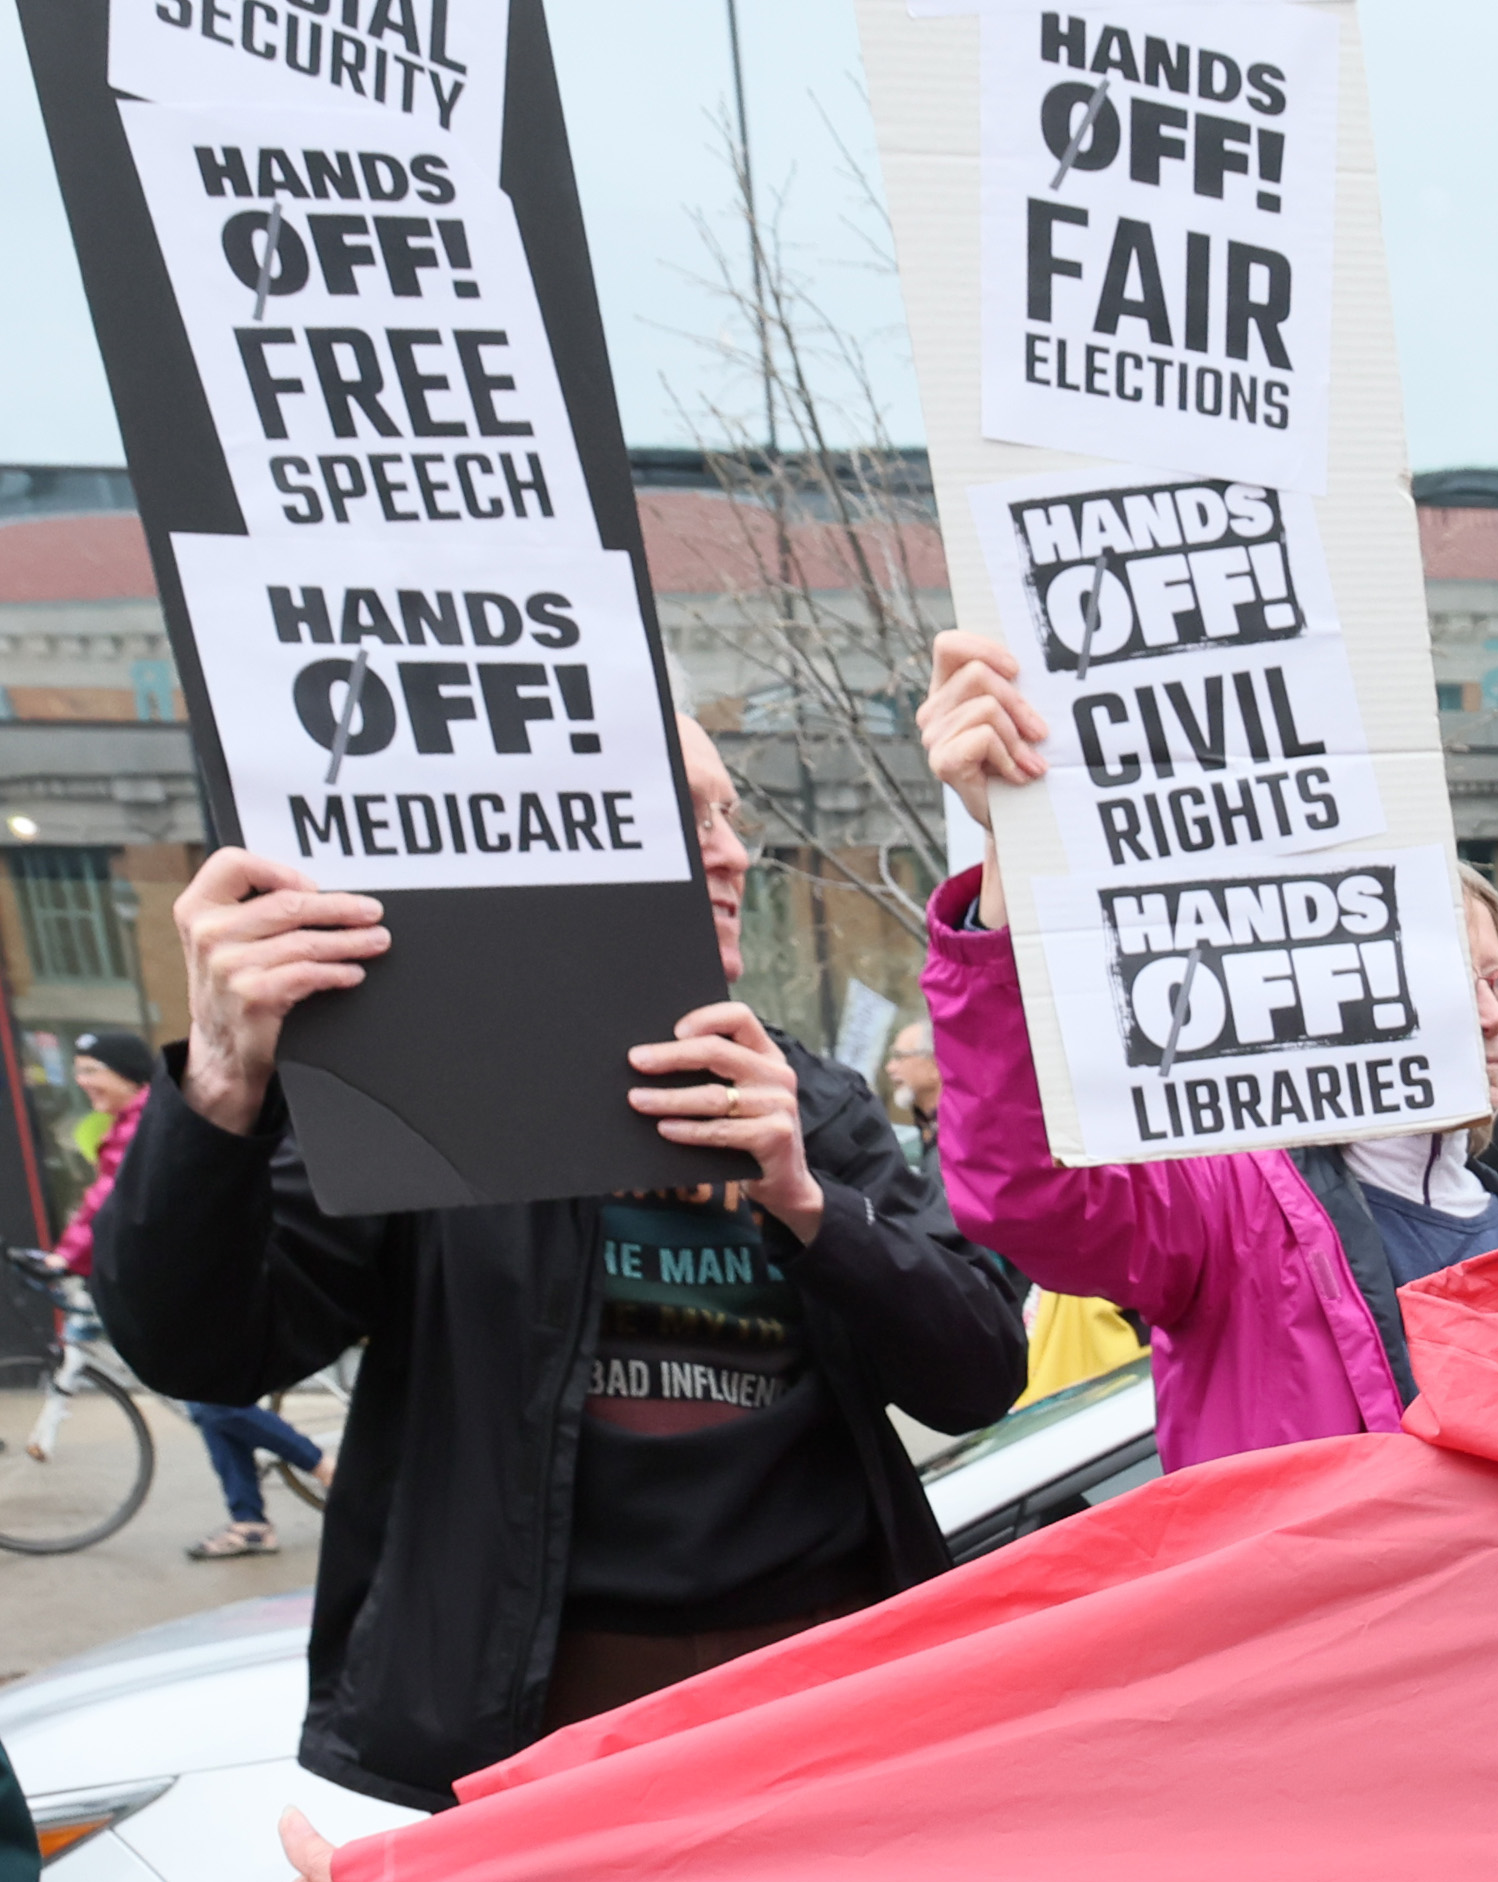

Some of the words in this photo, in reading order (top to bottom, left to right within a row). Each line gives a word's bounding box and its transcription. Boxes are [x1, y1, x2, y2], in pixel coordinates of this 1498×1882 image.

[1040, 11, 1287, 117] HANDS
[193, 145, 457, 205] HANDS
[1040, 80, 1286, 214] OFF!
[221, 205, 481, 302] OFF!
[1026, 196, 1294, 372] FAIR
[232, 326, 535, 440] FREE
[1025, 332, 1290, 431] ELECTIONS
[269, 452, 556, 525] SPEECH
[1022, 484, 1275, 567] HANDS
[266, 585, 581, 649] HANDS
[1046, 541, 1297, 658] OFF!
[292, 655, 603, 762] OFF!
[1071, 666, 1326, 788] CIVIL
[287, 790, 644, 858] MEDICARE
[1094, 765, 1341, 866] RIGHTS
[1111, 875, 1390, 955] HANDS
[1129, 939, 1408, 1054] OFF!
[1130, 1054, 1436, 1142] LIBRARIES
[659, 1247, 754, 1285] MAN
[588, 1359, 650, 1398] BAD
[660, 1361, 784, 1408] INFLUEN
